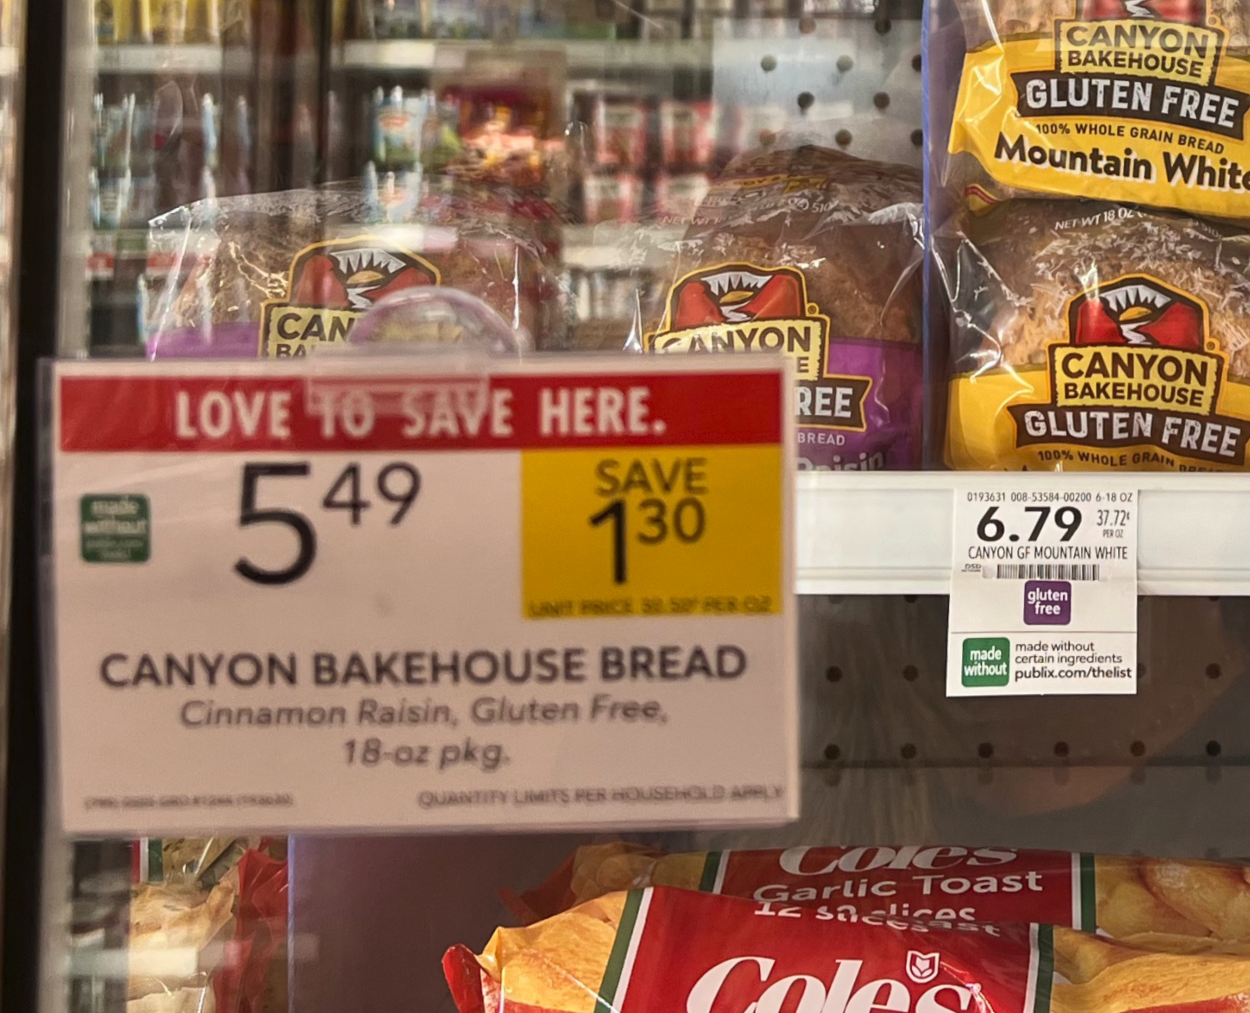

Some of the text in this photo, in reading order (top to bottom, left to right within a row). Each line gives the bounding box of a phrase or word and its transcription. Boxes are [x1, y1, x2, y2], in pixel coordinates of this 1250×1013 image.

[1065, 24, 1208, 59] CANYON
[1067, 51, 1203, 78] BAKEHOUSE
[1025, 79, 1240, 129] GLUTEN FREE
[1036, 123, 1224, 156] 100% WHOLE GRAIN BREAD
[994, 131, 1156, 183] Mountain
[1055, 219, 1077, 230] NET
[1081, 217, 1101, 228] WT
[1103, 210, 1115, 222] 18
[1061, 351, 1208, 387] CANYON
[1064, 382, 1204, 408] BAKEHOUSE
[176, 387, 666, 438] LOVE TO SAVE HERE.
[797, 433, 845, 447] BREAD
[1024, 410, 1241, 458] GLUTEN FREE
[594, 457, 708, 497] SAVE
[967, 492, 1006, 502] 0193631
[1120, 492, 1133, 503] OZ
[977, 506, 1082, 542] 6.79
[968, 546, 1128, 559] CANYON GF MOUNTAIN WHITE
[1027, 588, 1068, 604] gluten
[970, 646, 1002, 660] made
[1015, 641, 1094, 651] made without
[1015, 654, 1123, 666] certain ingredients
[100, 645, 747, 688] CANYON BAKEHOUSE BREAD
[964, 662, 1007, 676] without
[1015, 666, 1132, 681] publix.com/thelist
[180, 693, 668, 729] Cinnamon Raisin, Gluten Free,
[345, 736, 510, 774] 18-oz pkg.
[753, 871, 1042, 903] Garlic Toast
